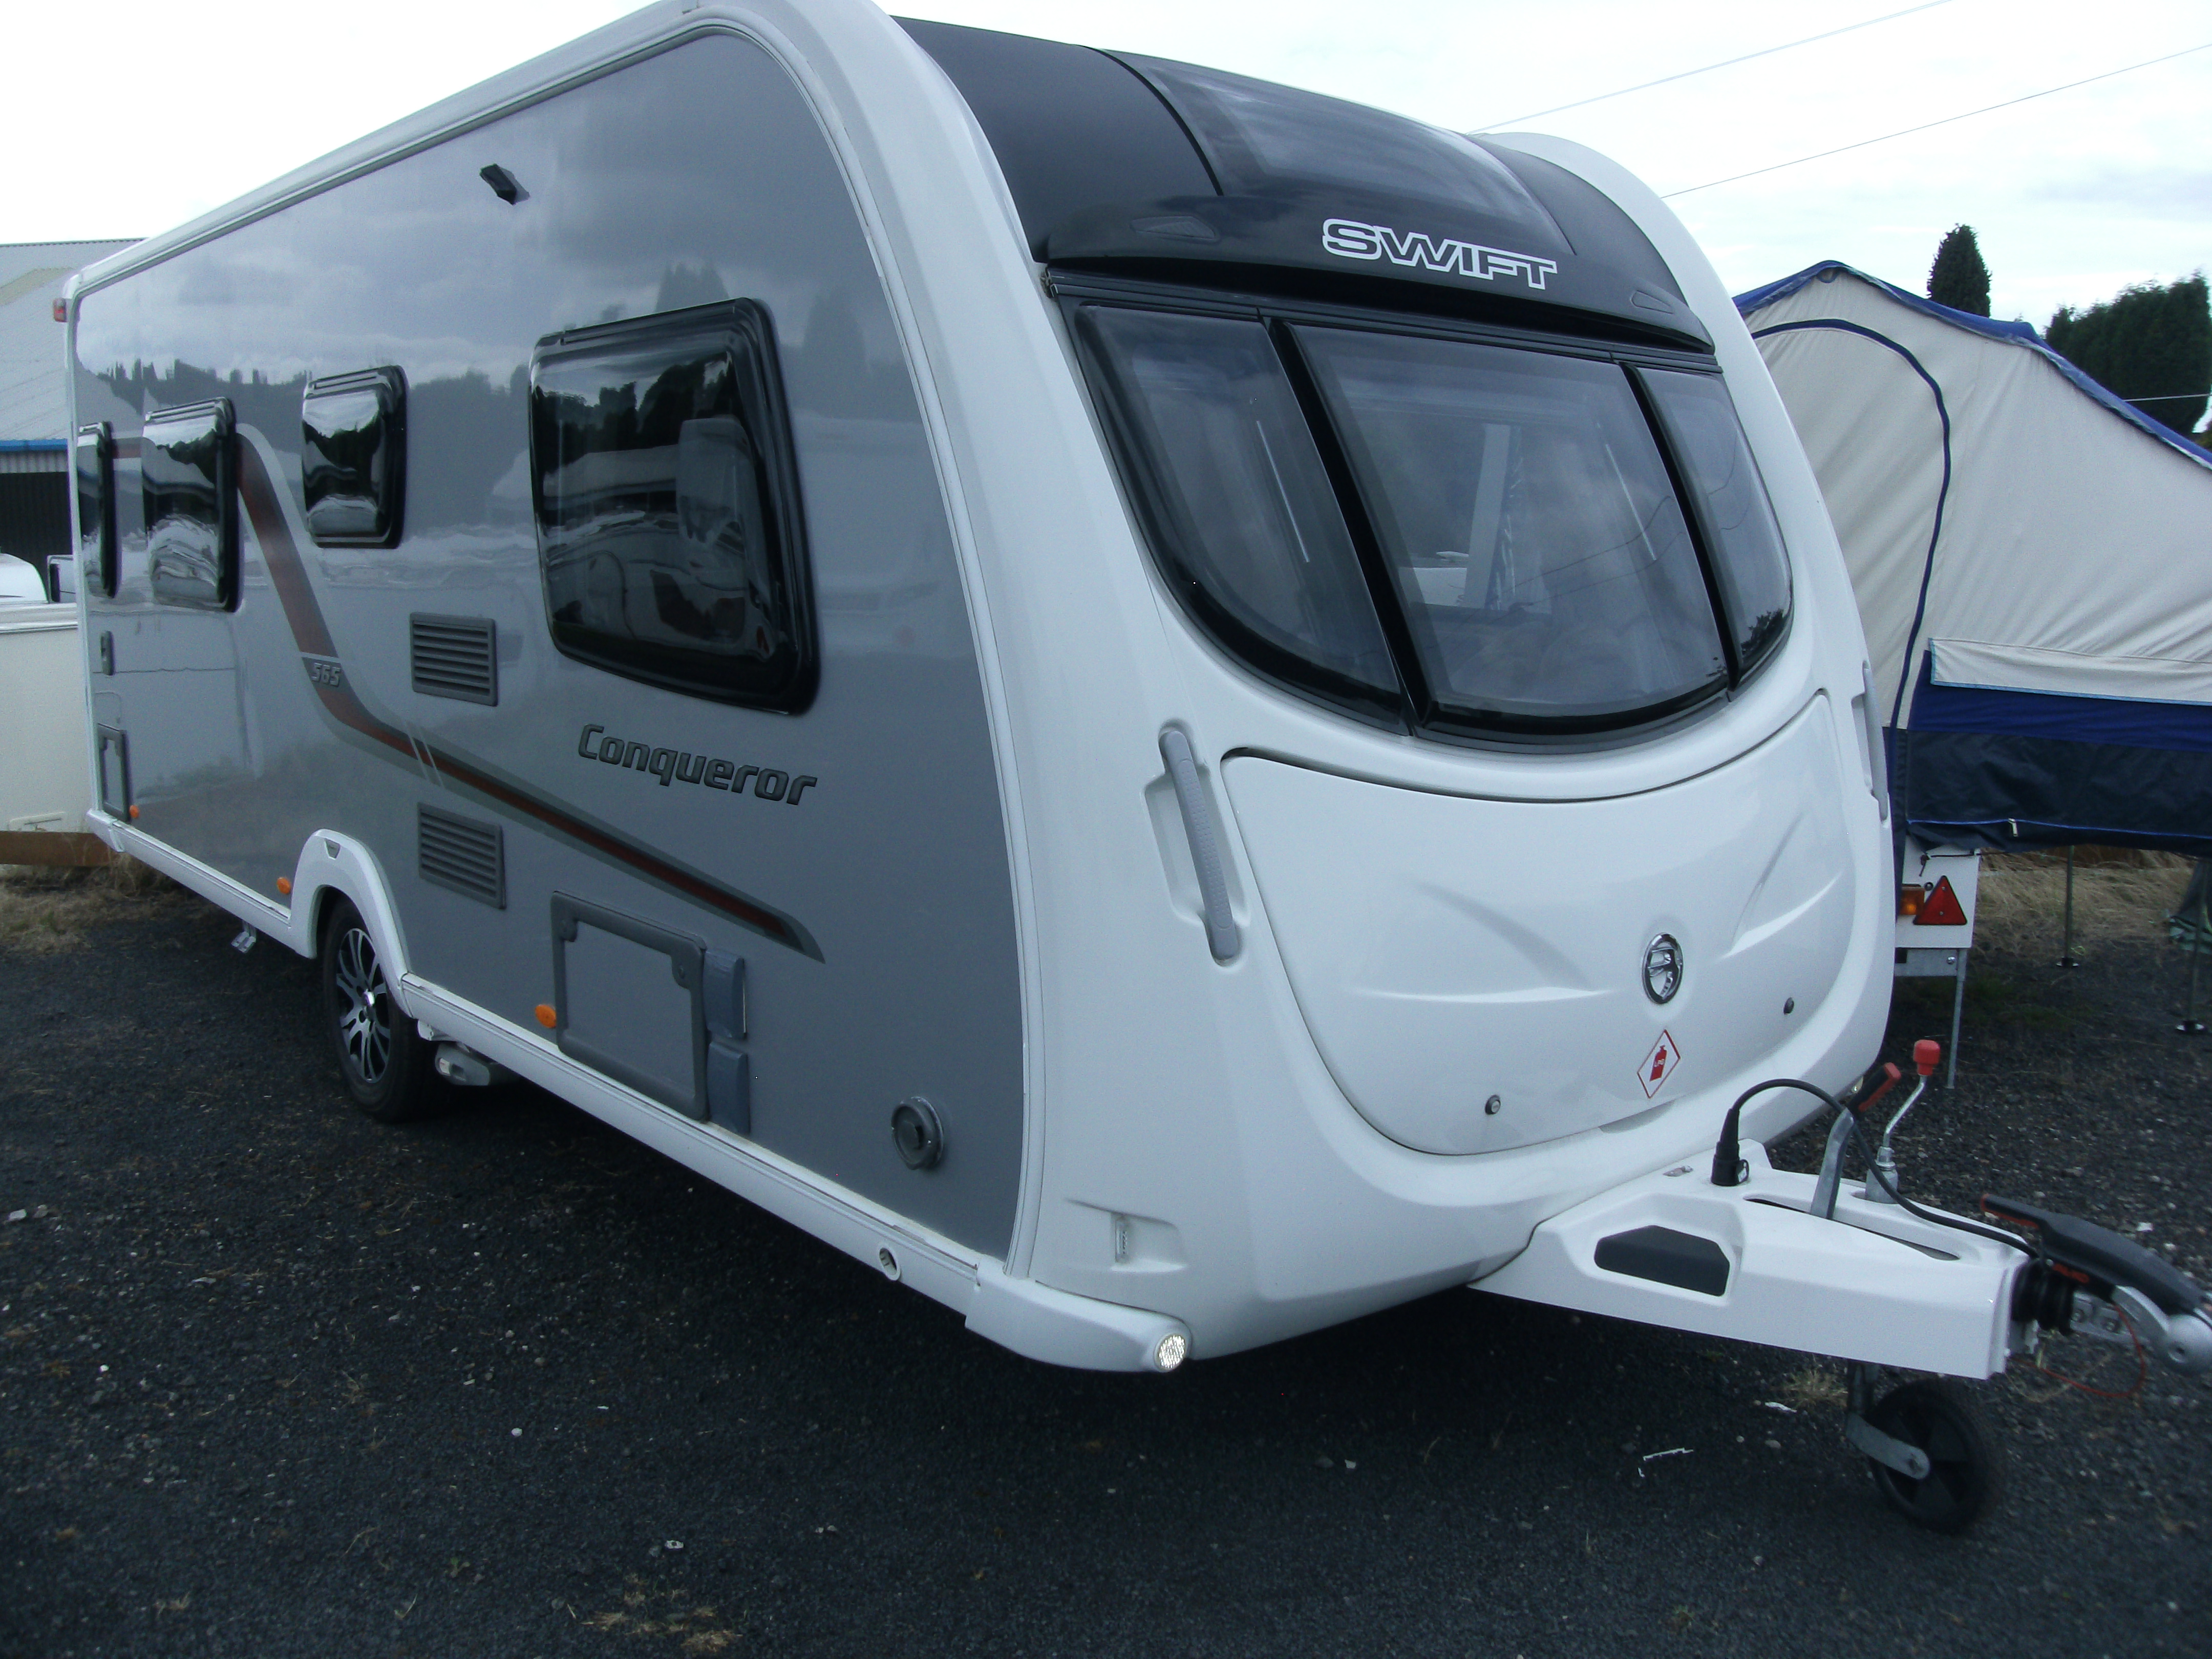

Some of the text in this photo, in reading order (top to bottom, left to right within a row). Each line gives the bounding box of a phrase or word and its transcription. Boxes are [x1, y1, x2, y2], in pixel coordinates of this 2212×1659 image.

[1322, 219, 1558, 290] SWIFT
[310, 662, 342, 687] 565
[578, 724, 818, 805] Conqueror
